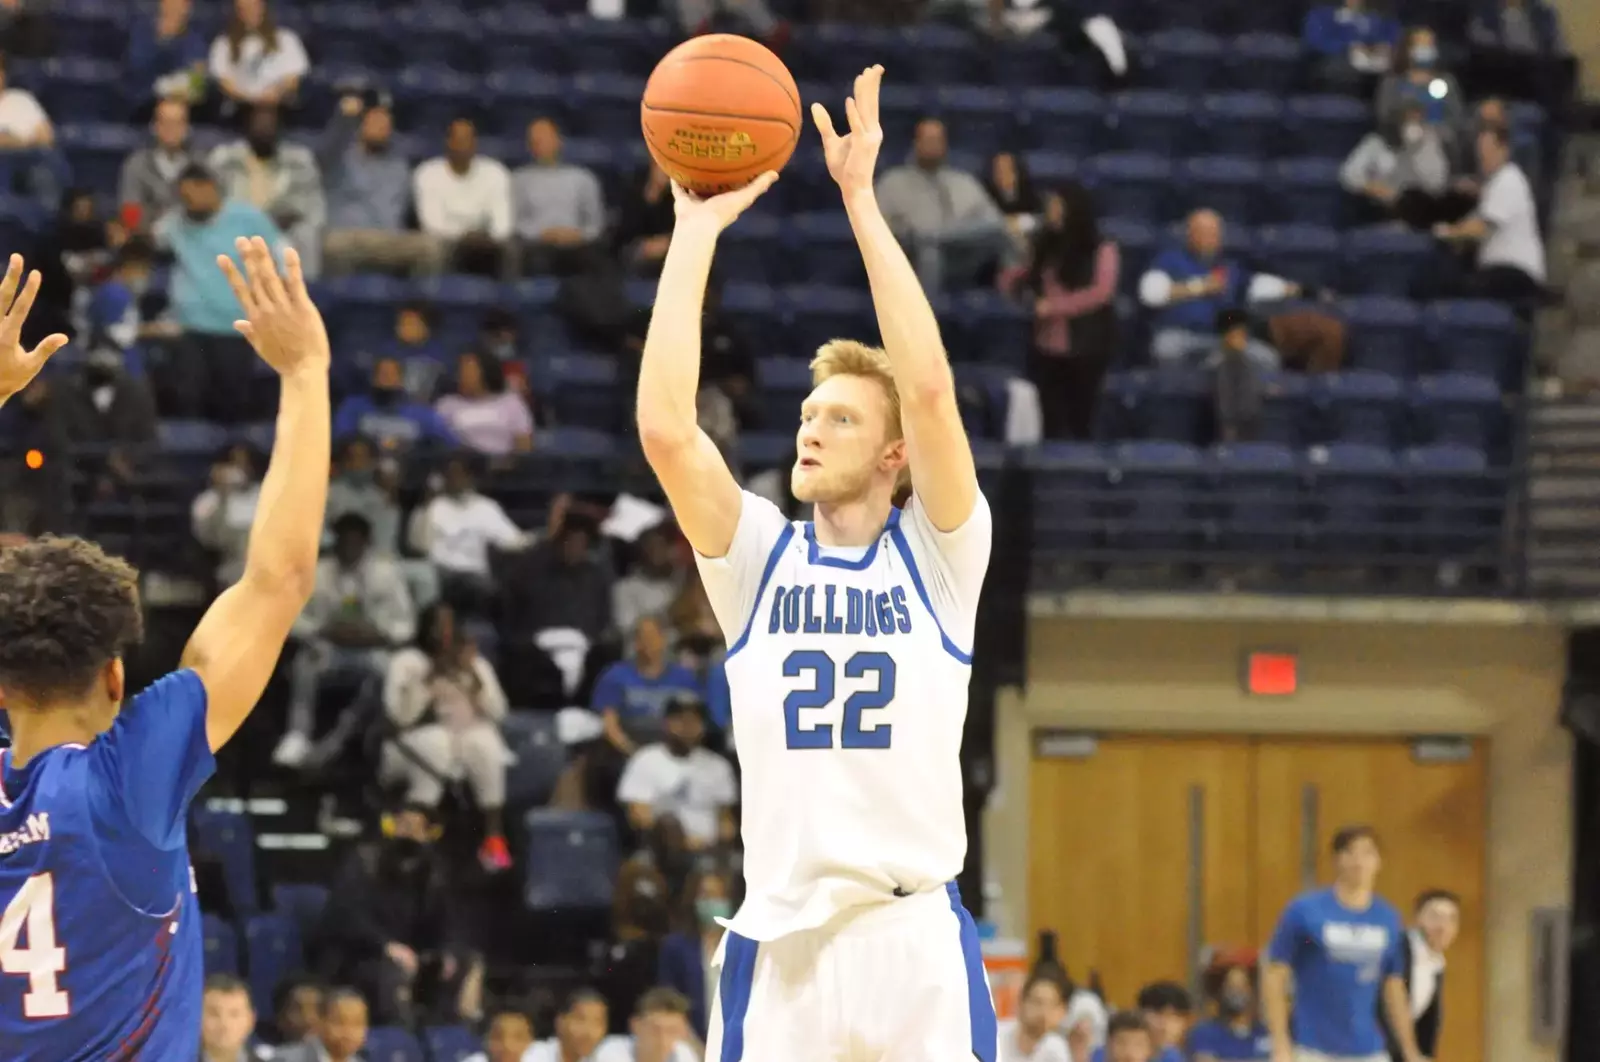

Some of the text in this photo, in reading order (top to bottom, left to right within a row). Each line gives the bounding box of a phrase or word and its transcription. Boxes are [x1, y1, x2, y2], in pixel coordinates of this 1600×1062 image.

[768, 584, 911, 636] BULLDOGS
[782, 650, 896, 750] 22
[0, 873, 69, 1018] 4
